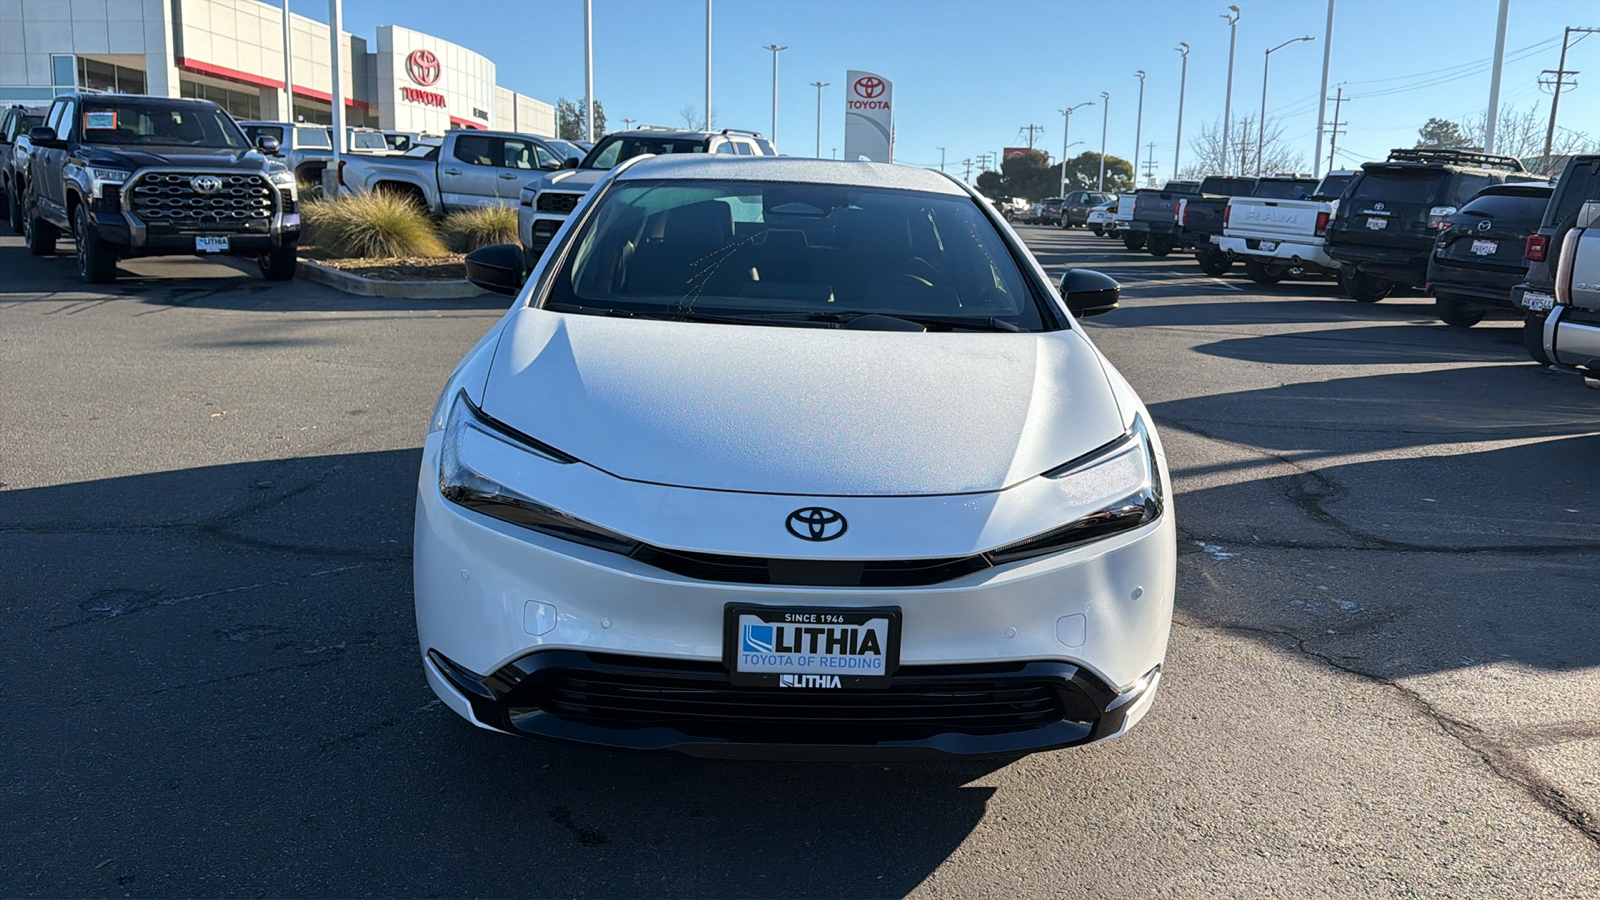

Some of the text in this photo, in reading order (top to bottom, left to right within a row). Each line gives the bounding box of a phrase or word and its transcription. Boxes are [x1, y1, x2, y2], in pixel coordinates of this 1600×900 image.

[402, 86, 446, 108] TOYOTA
[847, 100, 890, 110] TOYOTA
[1245, 211, 1299, 224] RAM
[785, 613, 844, 623] SINCE 1946
[775, 626, 882, 656] LITHIA
[742, 653, 882, 669] TOYOTA OF REDDING
[794, 675, 842, 689] LITHIA
